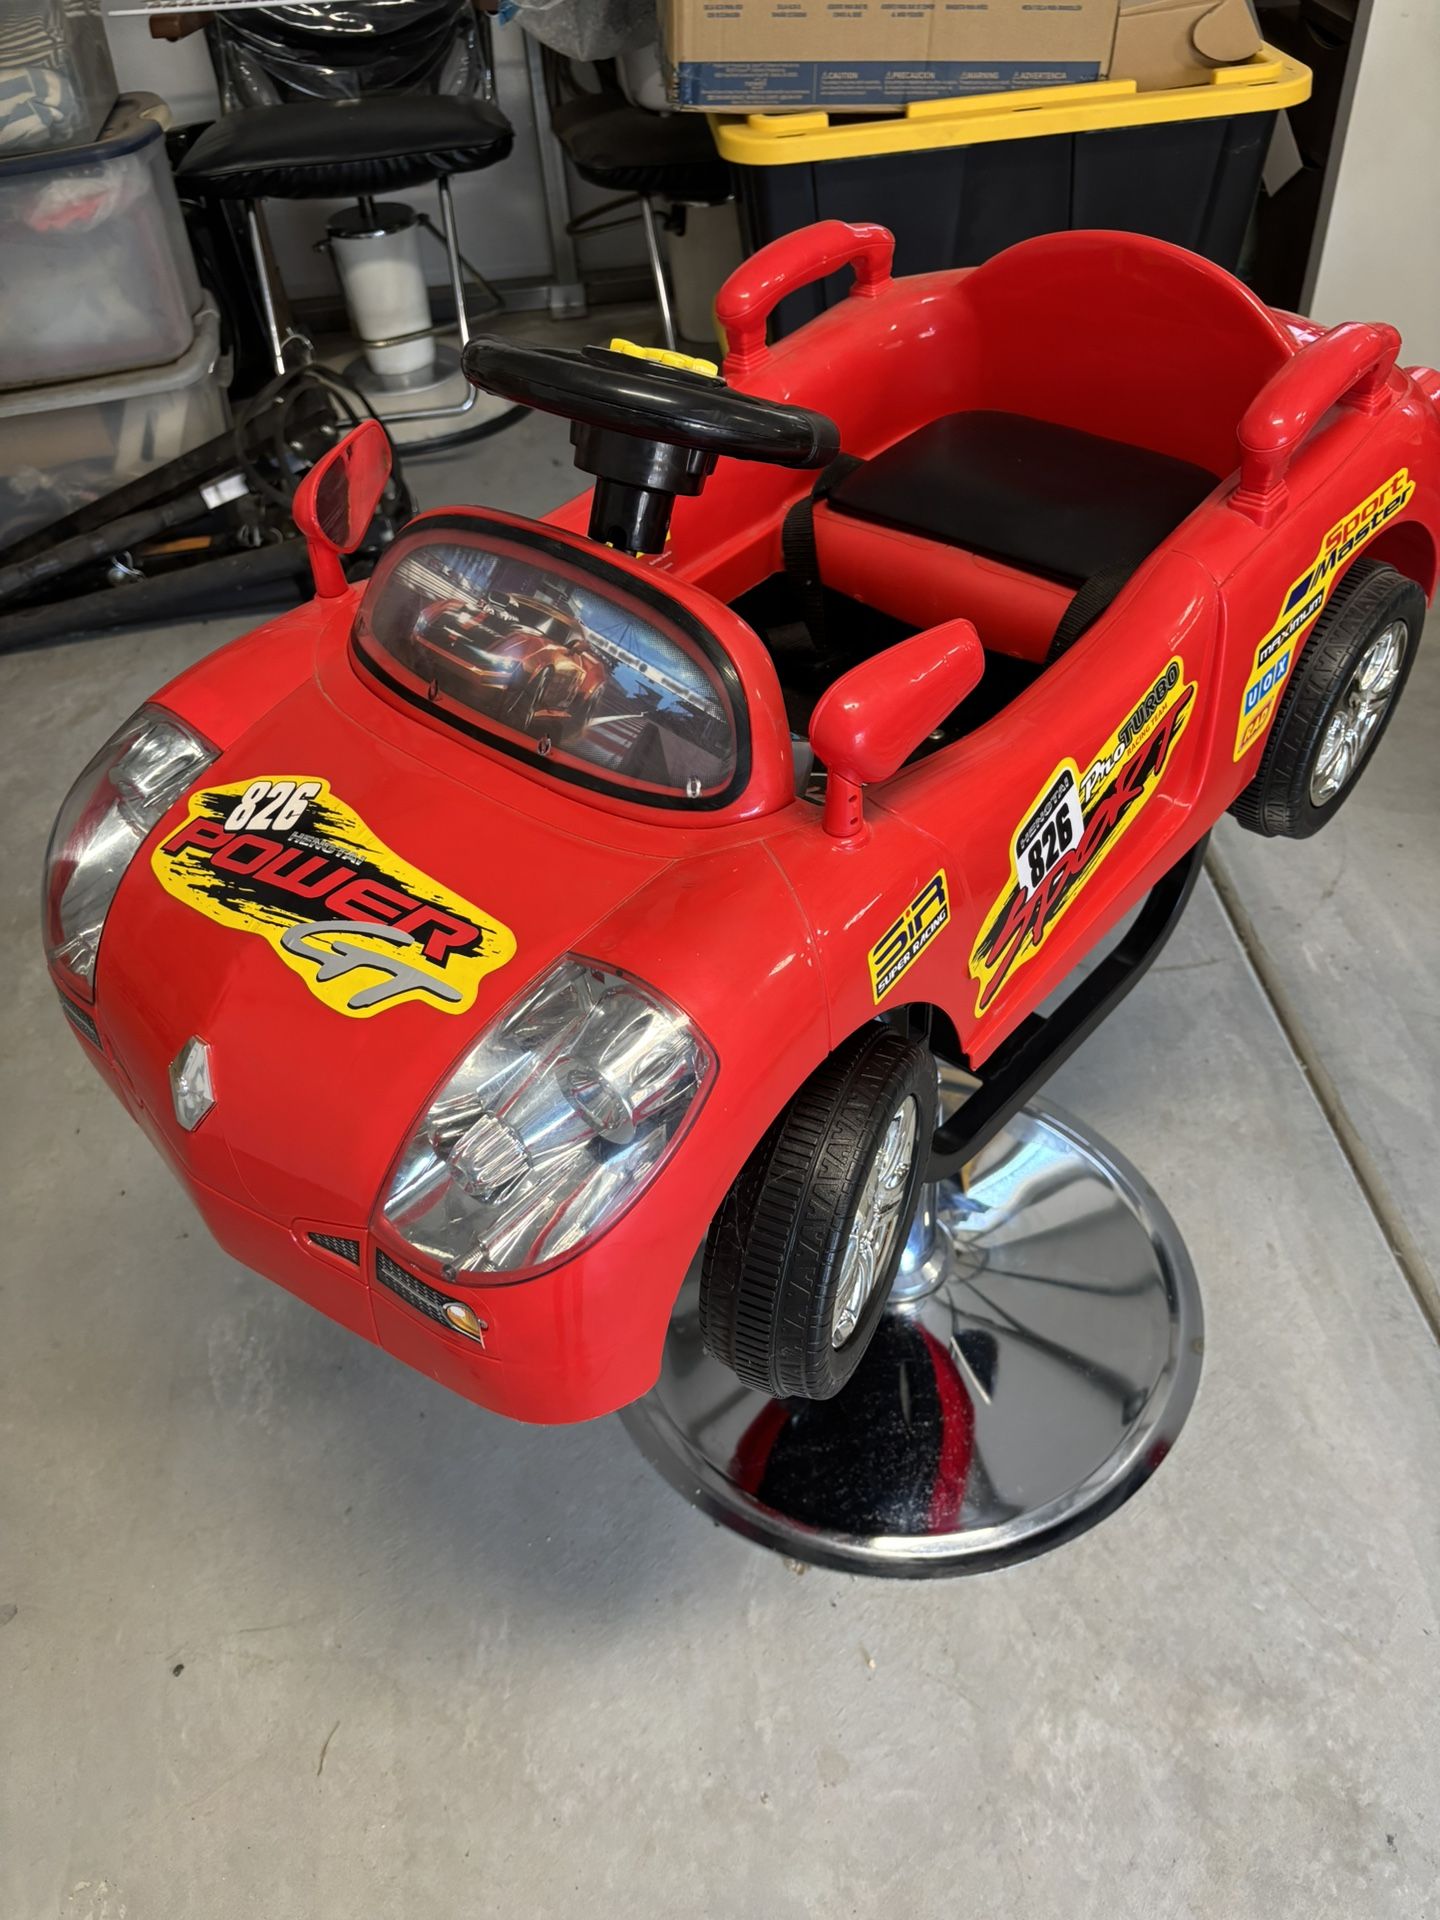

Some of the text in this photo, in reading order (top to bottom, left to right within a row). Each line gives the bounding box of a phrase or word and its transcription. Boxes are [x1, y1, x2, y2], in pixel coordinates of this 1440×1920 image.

[1313, 485, 1412, 588] Master
[1324, 475, 1404, 556] Sport
[1126, 703, 1168, 757] RACING TEAM
[223, 781, 322, 831] 826
[1019, 775, 1071, 850] HENGTAI
[1027, 803, 1074, 889] 826
[287, 831, 367, 866] HENGTAI
[161, 816, 483, 968] POWER
[281, 920, 463, 1009] GT
[877, 909, 946, 994] SUPER RACING
